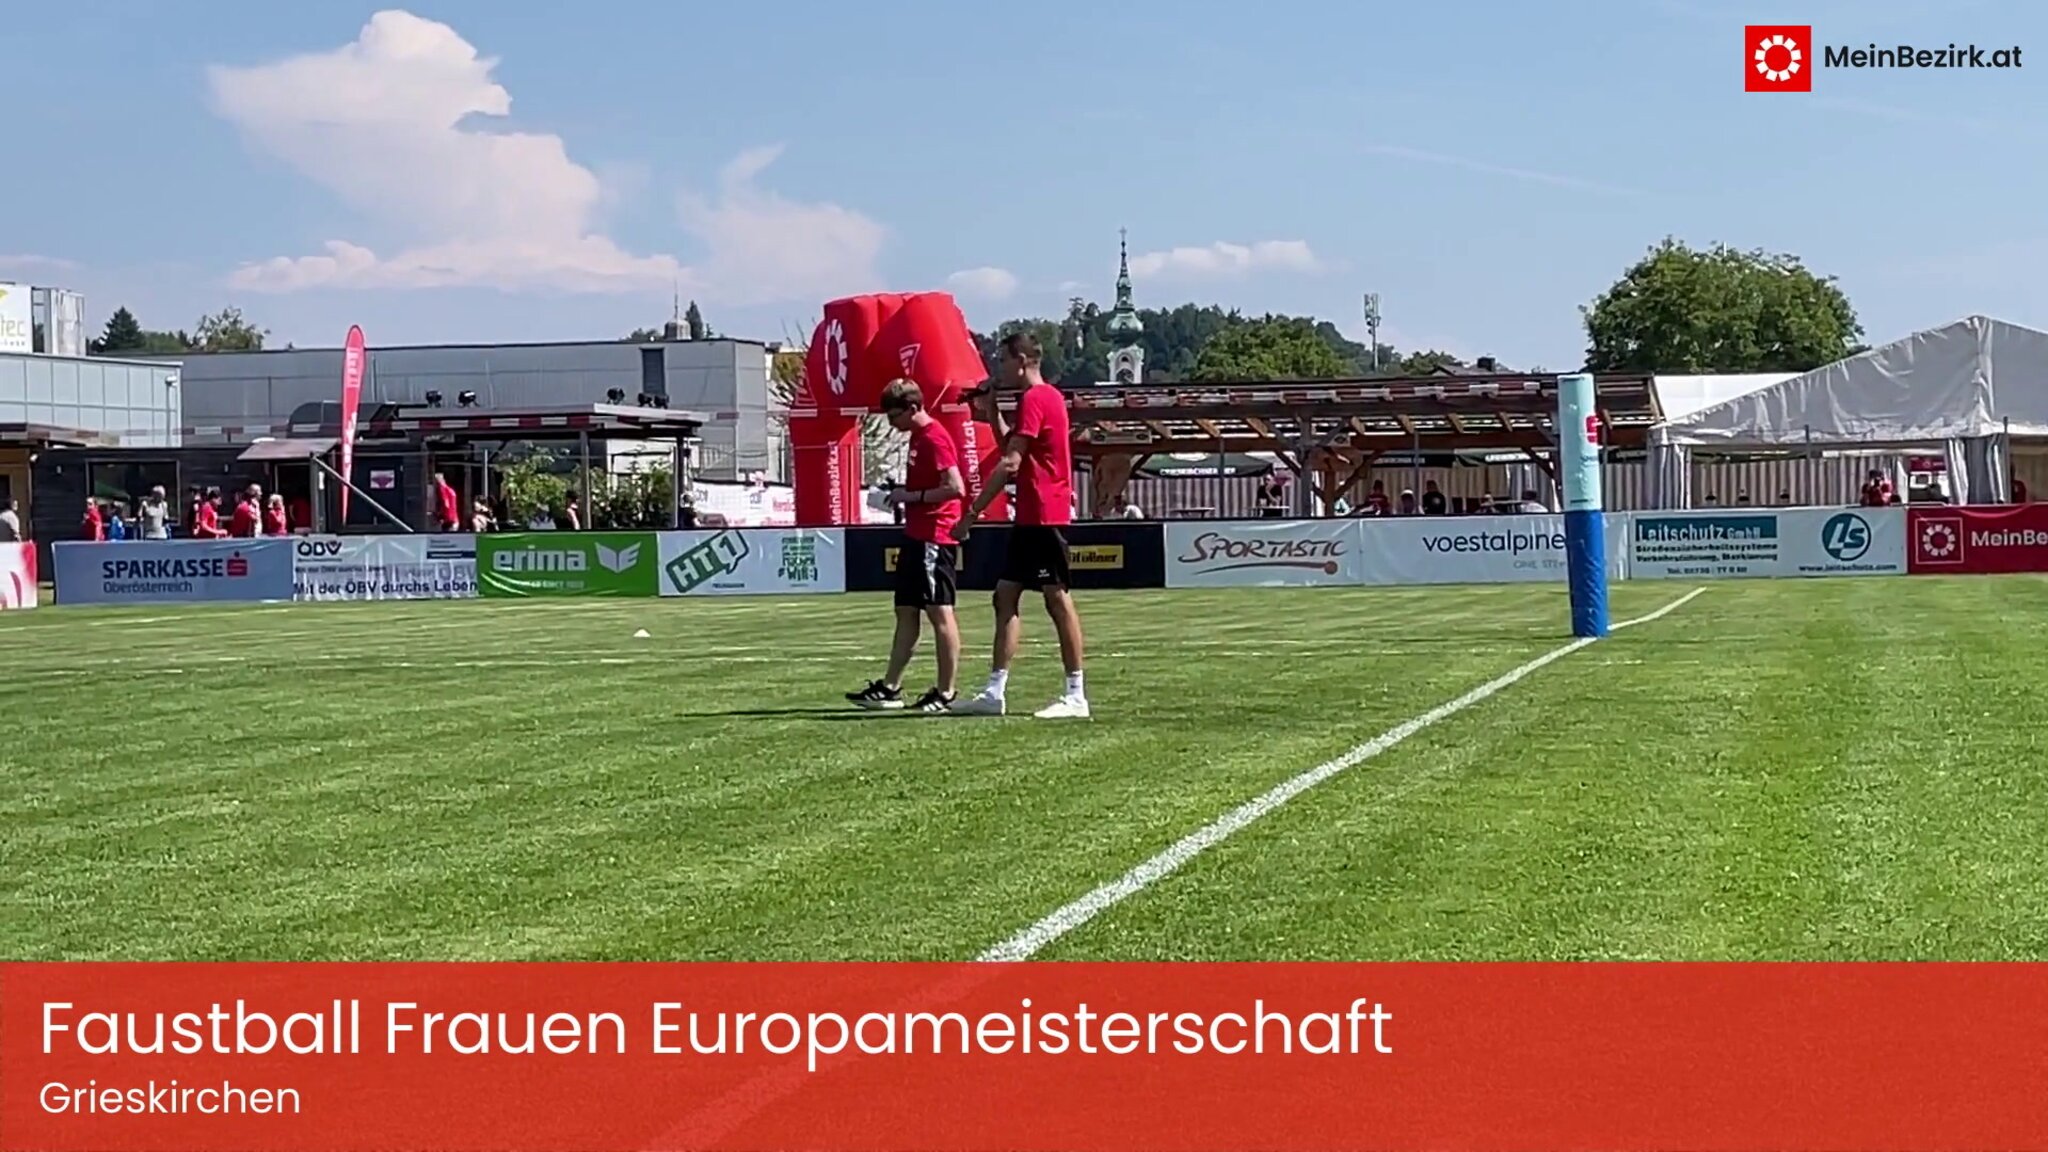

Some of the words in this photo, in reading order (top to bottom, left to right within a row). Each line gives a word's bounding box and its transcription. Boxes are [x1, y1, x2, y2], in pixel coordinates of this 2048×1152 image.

[1422, 529, 1566, 556] voestalpine
[1638, 522, 1724, 542] Leitschutz
[493, 544, 586, 571] erima
[672, 535, 738, 588] HT1
[103, 558, 223, 579] SPARKASSE
[103, 580, 193, 593] Oberösterreich
[318, 582, 340, 594] der
[345, 580, 377, 594] ÖBV
[381, 580, 429, 594] durchs
[434, 579, 478, 593] Leben
